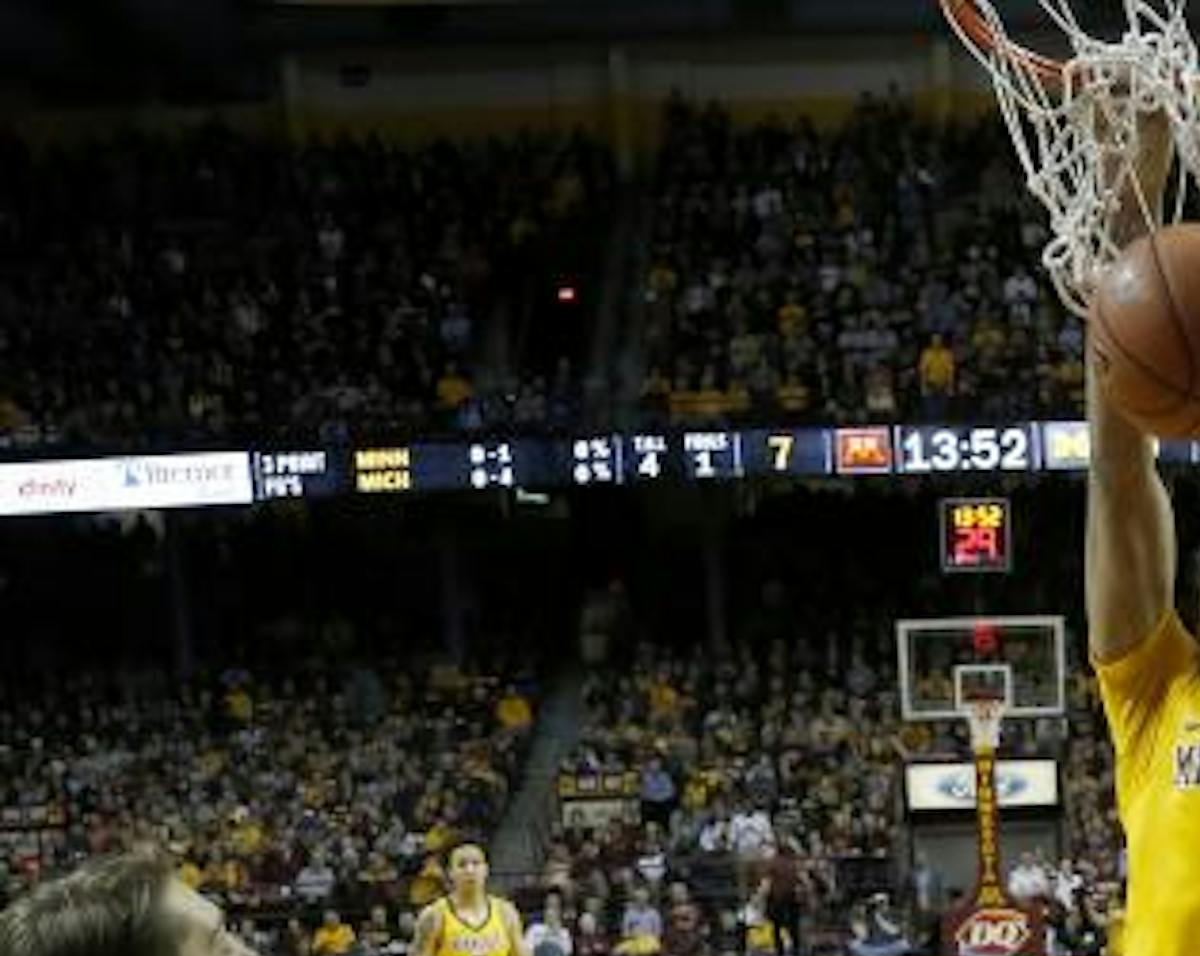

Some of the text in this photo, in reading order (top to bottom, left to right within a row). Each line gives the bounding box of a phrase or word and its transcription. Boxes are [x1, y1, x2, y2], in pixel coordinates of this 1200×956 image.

[638, 451, 661, 478] 4
[768, 436, 794, 470] 7
[903, 429, 1028, 471] 13:52
